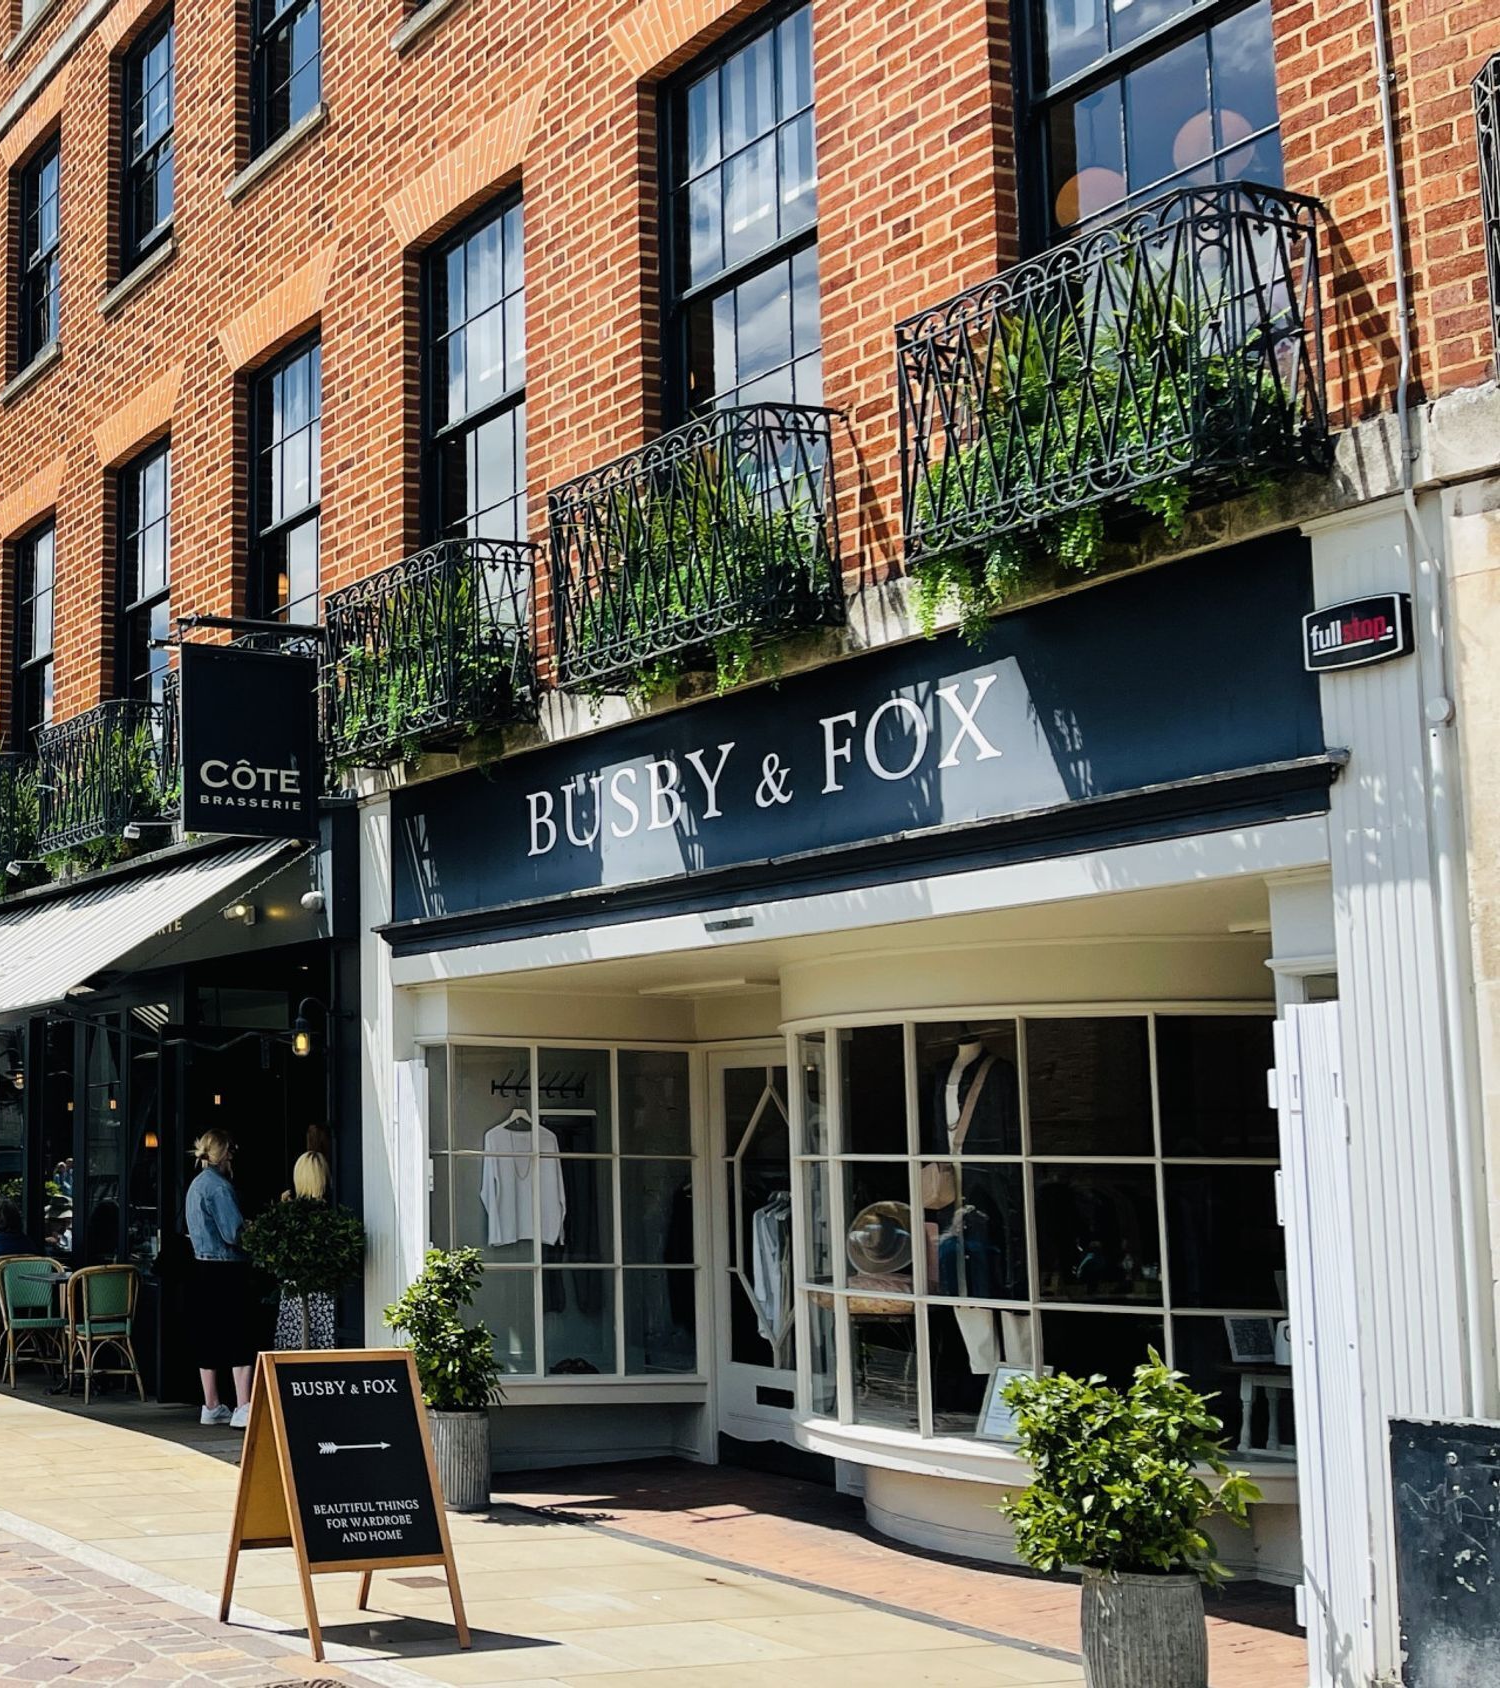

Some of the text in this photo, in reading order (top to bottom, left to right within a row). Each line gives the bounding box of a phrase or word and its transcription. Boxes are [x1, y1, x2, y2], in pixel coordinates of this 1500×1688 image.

[526, 674, 1003, 857] BUSBY & FOX
[200, 759, 300, 794] CÔTE
[200, 795, 301, 810] BRASSERIE
[291, 1379, 398, 1396] BUSBY & FOX
[313, 1499, 419, 1515] BEAUTIFUL THINGS
[326, 1515, 412, 1529] FOR WARDROBE
[342, 1530, 403, 1543] AND HOME
